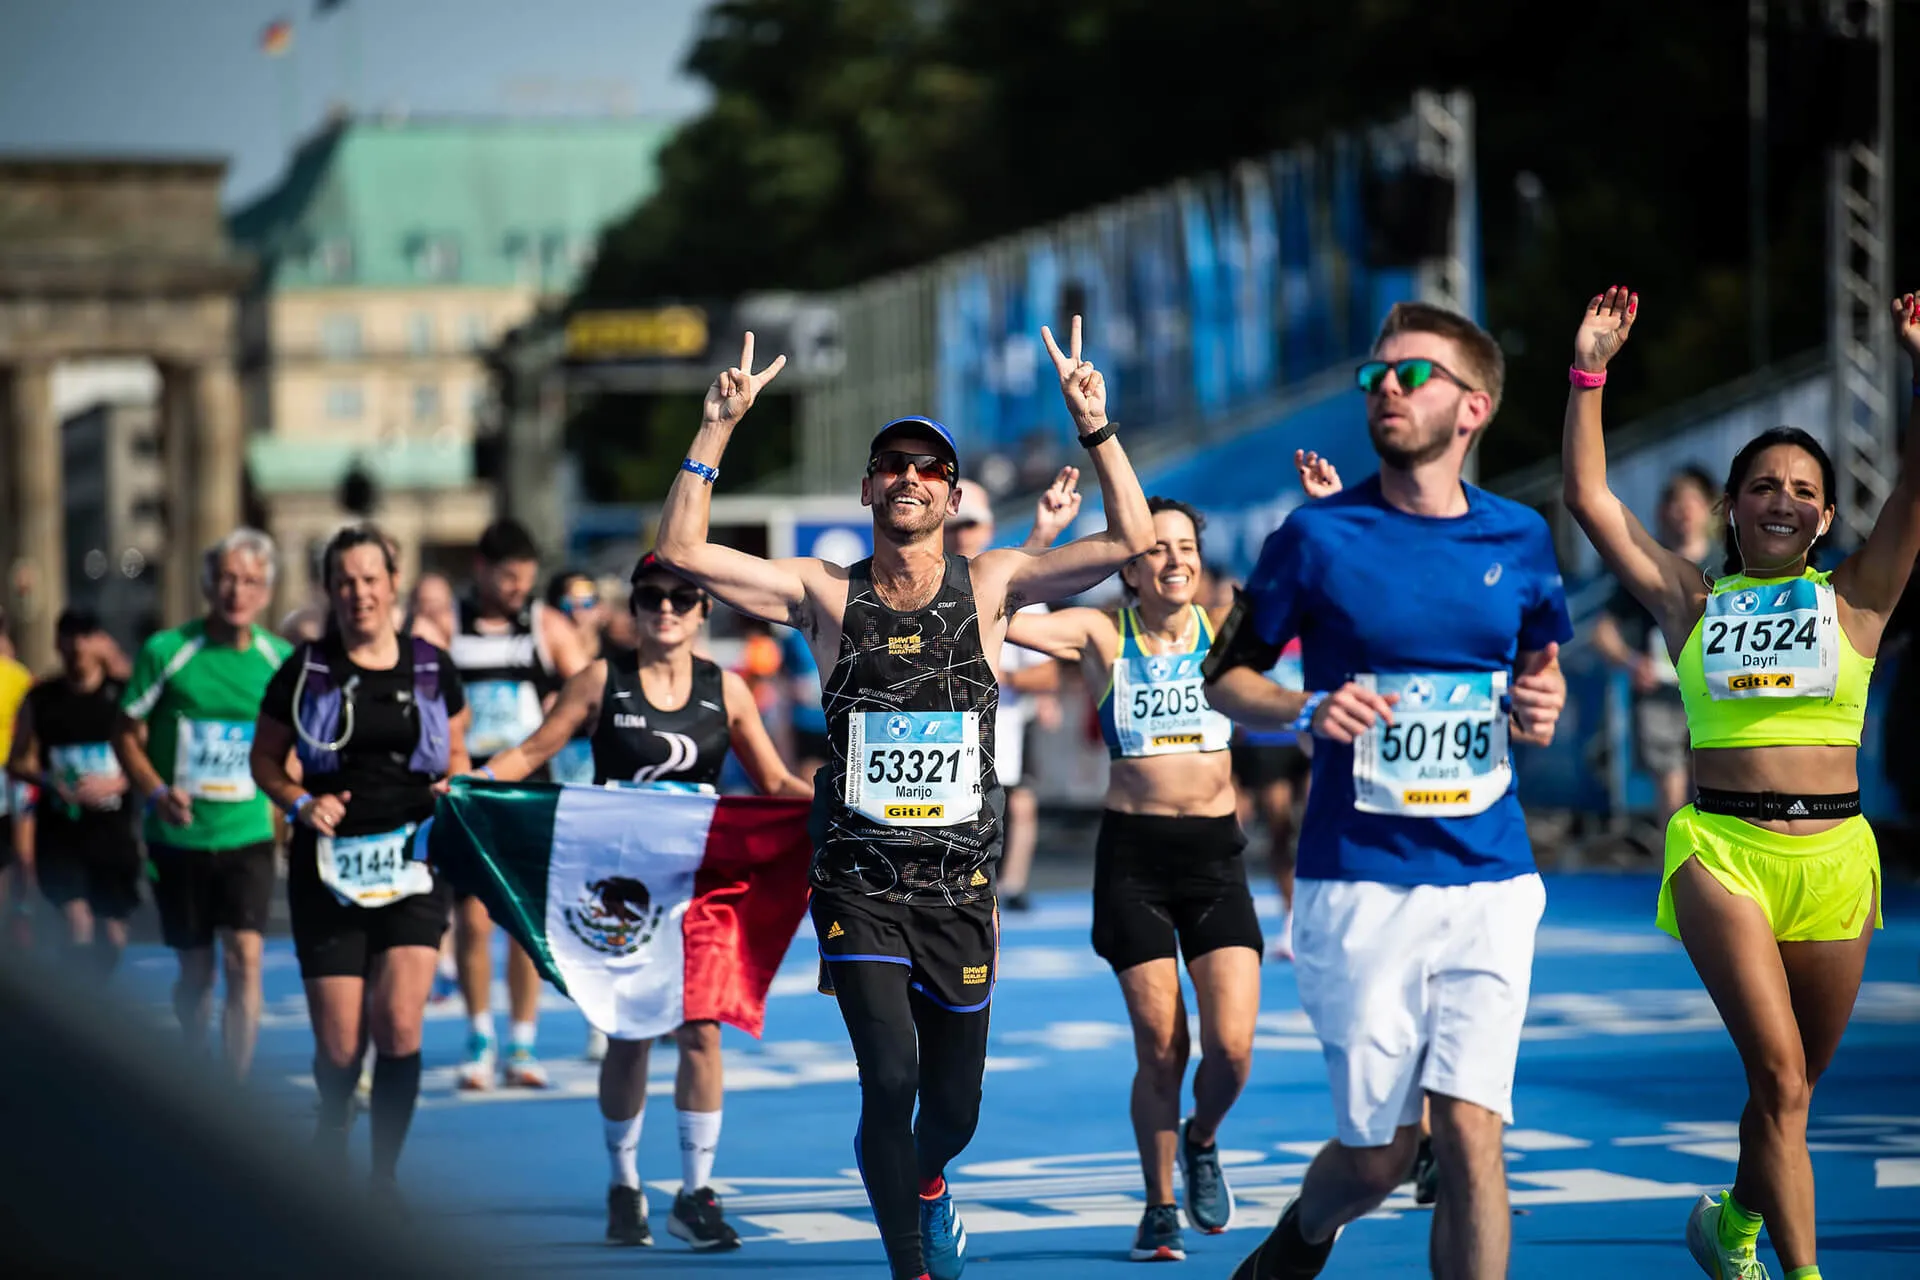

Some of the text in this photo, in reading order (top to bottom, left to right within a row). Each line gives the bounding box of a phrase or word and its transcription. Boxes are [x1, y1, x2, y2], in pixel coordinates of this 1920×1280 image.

[936, 601, 958, 609] START
[1706, 617, 1817, 655] 21524
[1742, 653, 1778, 669] Dayri
[1732, 676, 1768, 689] Giti
[1133, 685, 1212, 719] 5205
[1382, 720, 1492, 761] 50195
[966, 747, 975, 757] H
[867, 749, 960, 784] 53321
[1418, 765, 1461, 779] Allard
[895, 785, 933, 800] Marijo
[888, 807, 922, 817] Giti
[938, 829, 983, 849] TIERGARTEN
